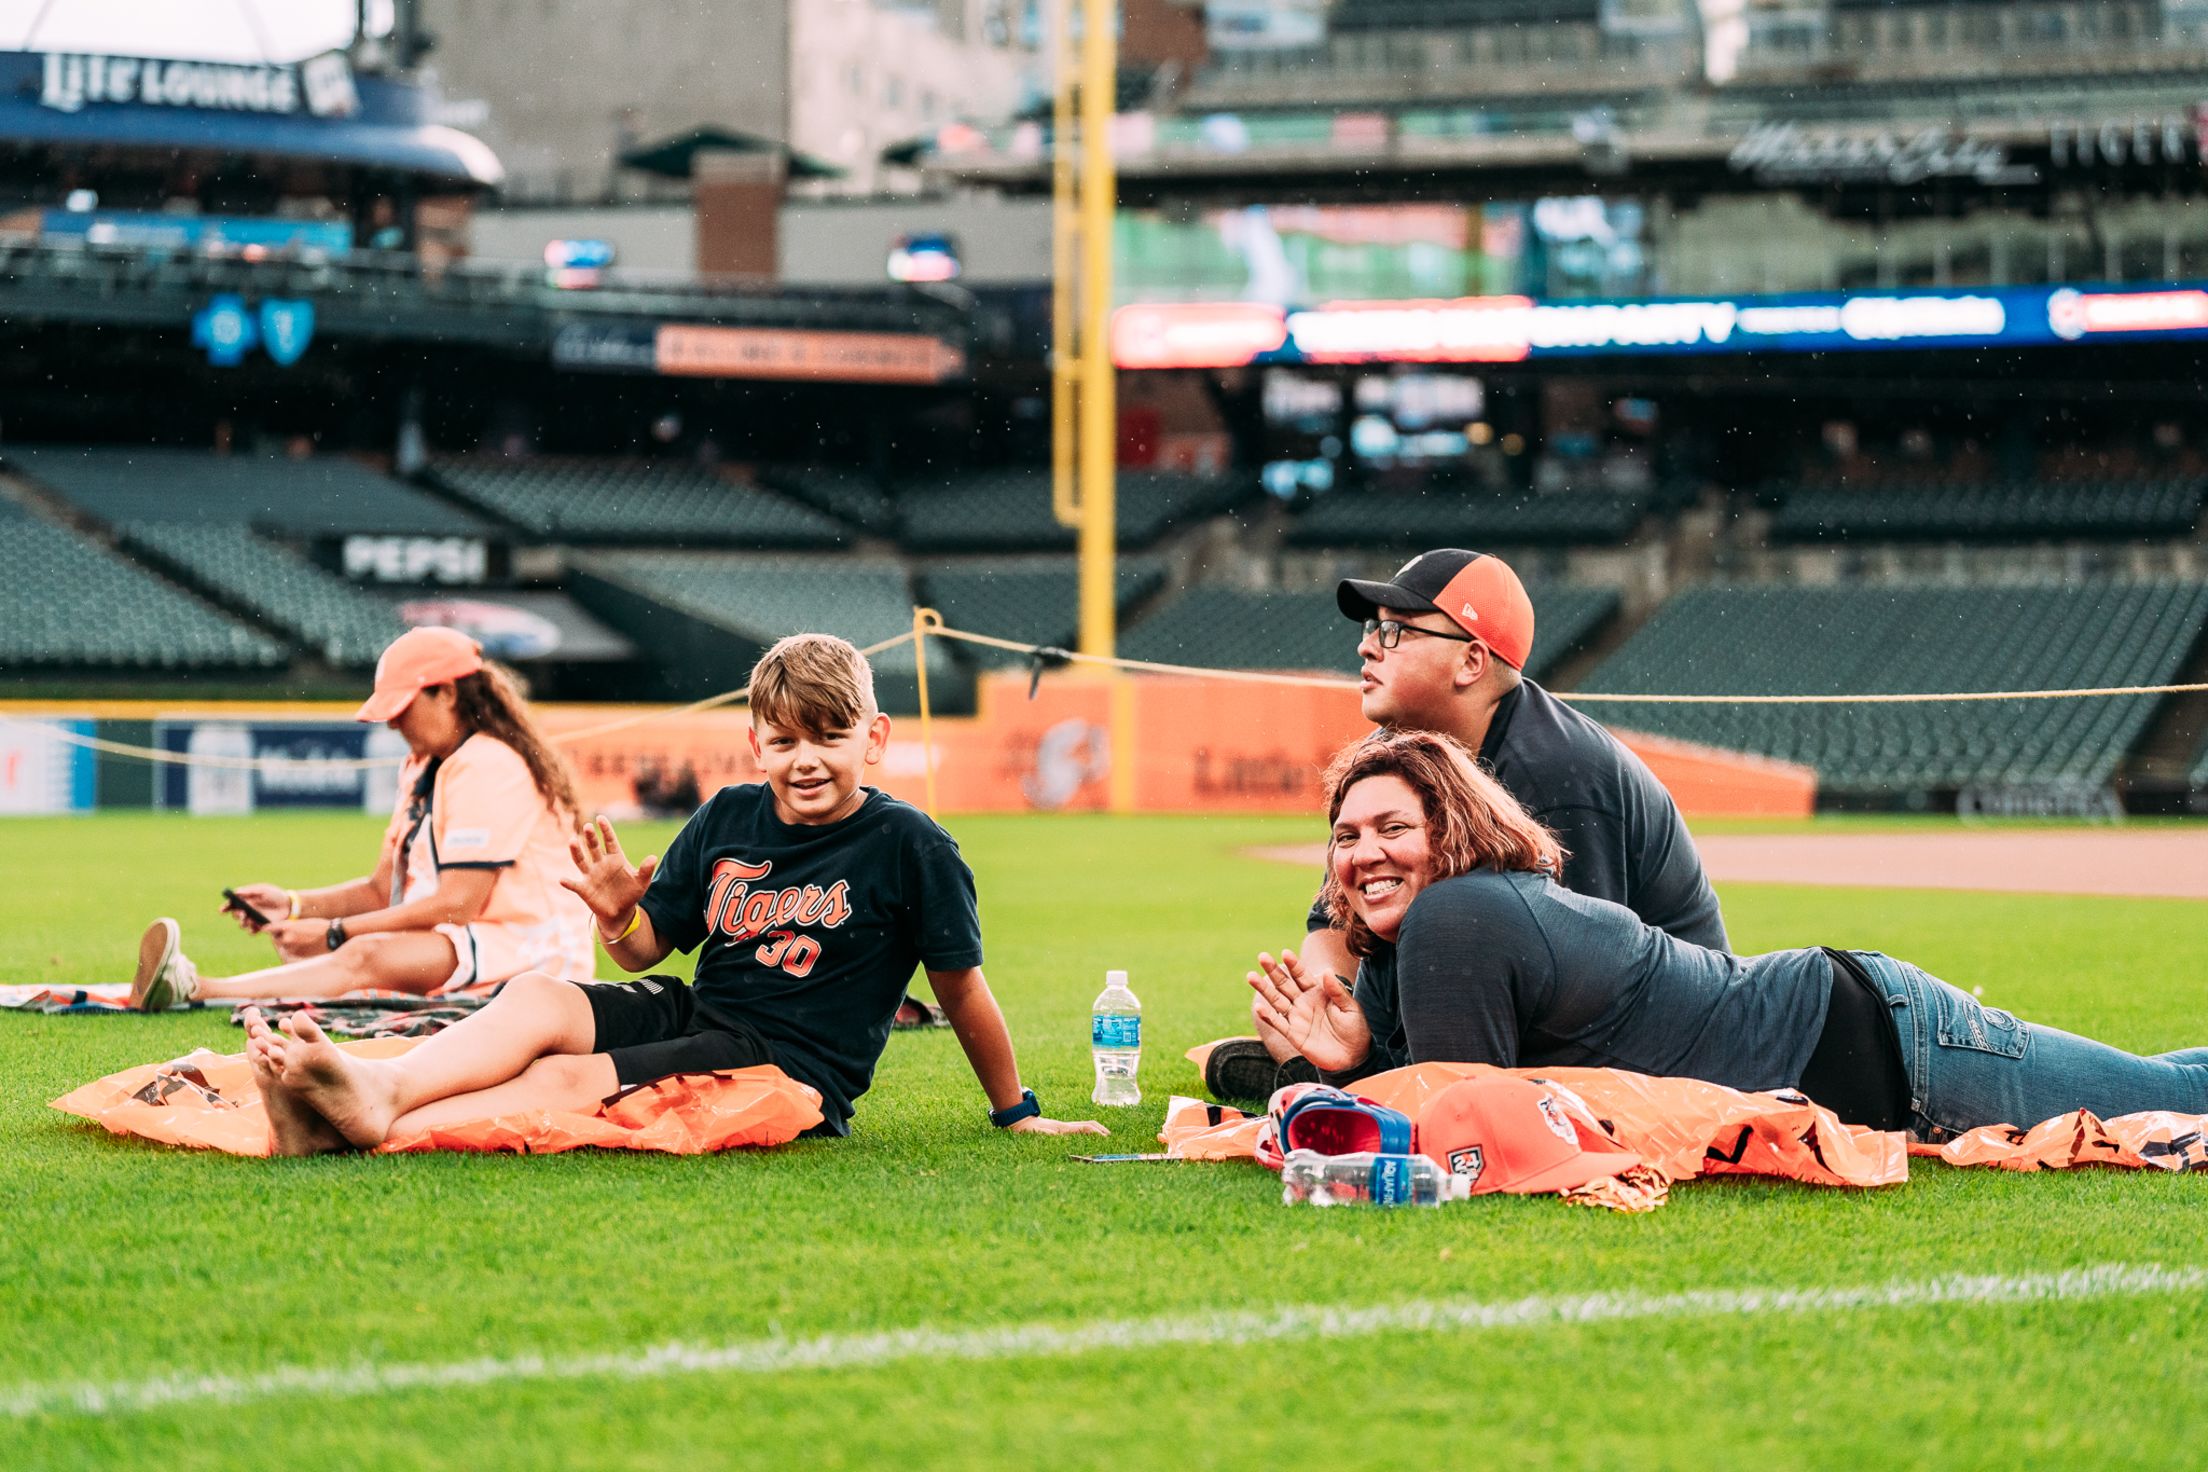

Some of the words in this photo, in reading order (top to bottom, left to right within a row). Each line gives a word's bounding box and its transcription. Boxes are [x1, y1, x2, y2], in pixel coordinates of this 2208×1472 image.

[343, 534, 487, 584] PEPSI
[704, 857, 853, 947] Tigers
[755, 929, 822, 978] 30
[1381, 1160, 1397, 1208] AQUAFIN
